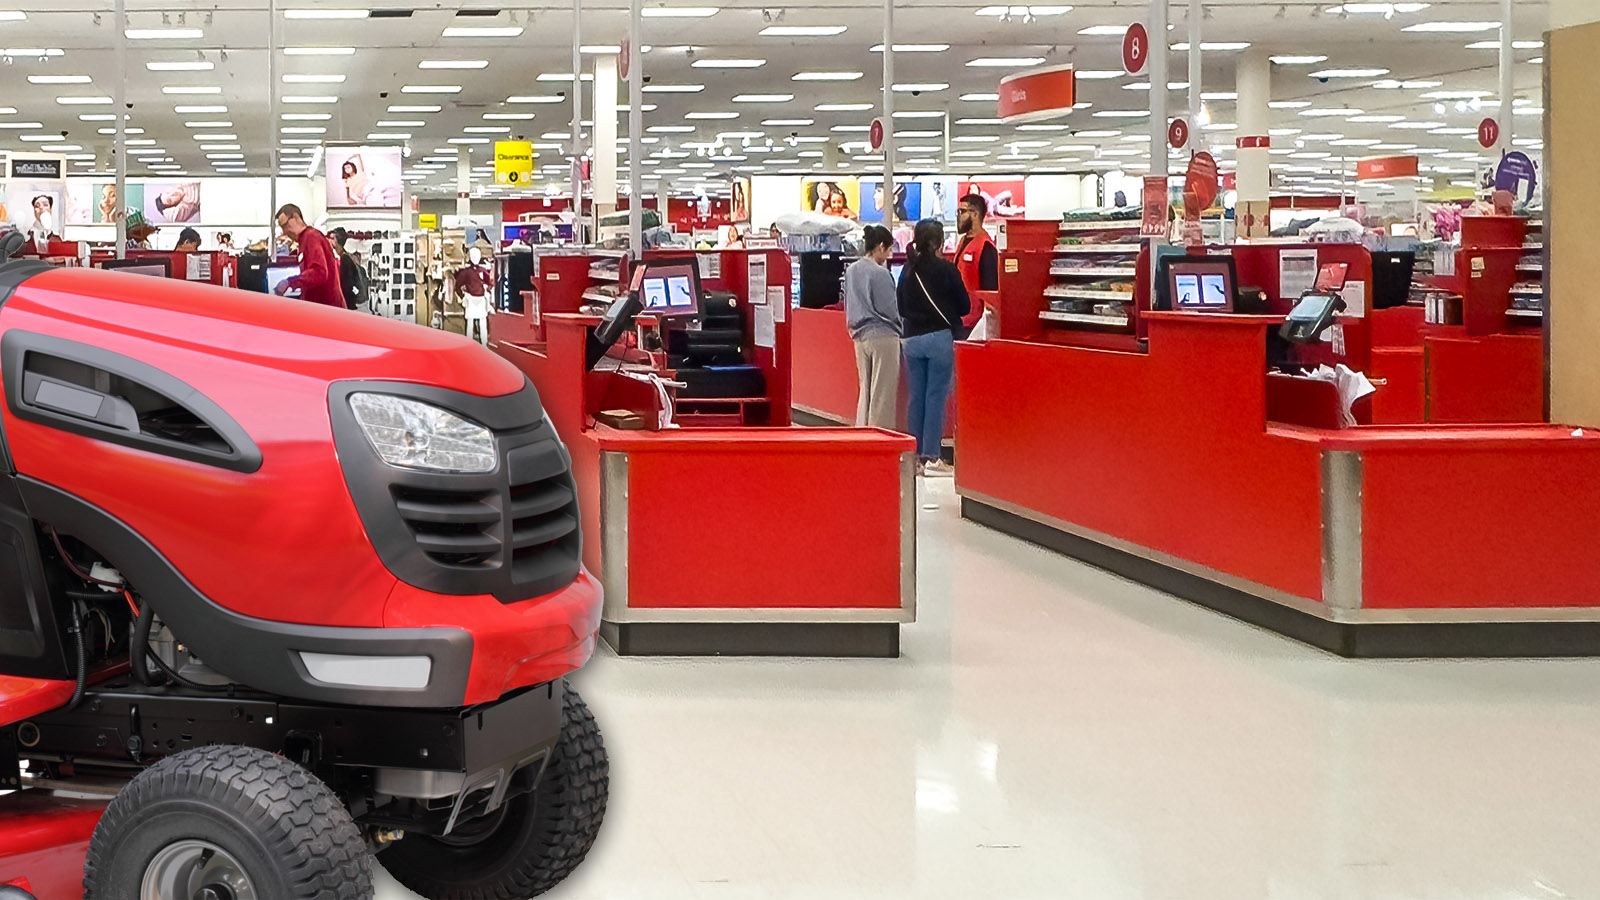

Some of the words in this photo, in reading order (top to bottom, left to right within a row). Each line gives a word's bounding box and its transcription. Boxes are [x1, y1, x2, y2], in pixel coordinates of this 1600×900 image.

[1131, 37, 1139, 59] 8
[1175, 127, 1181, 140] 9
[1484, 127, 1493, 140] 11
[497, 153, 530, 161] Clearance
